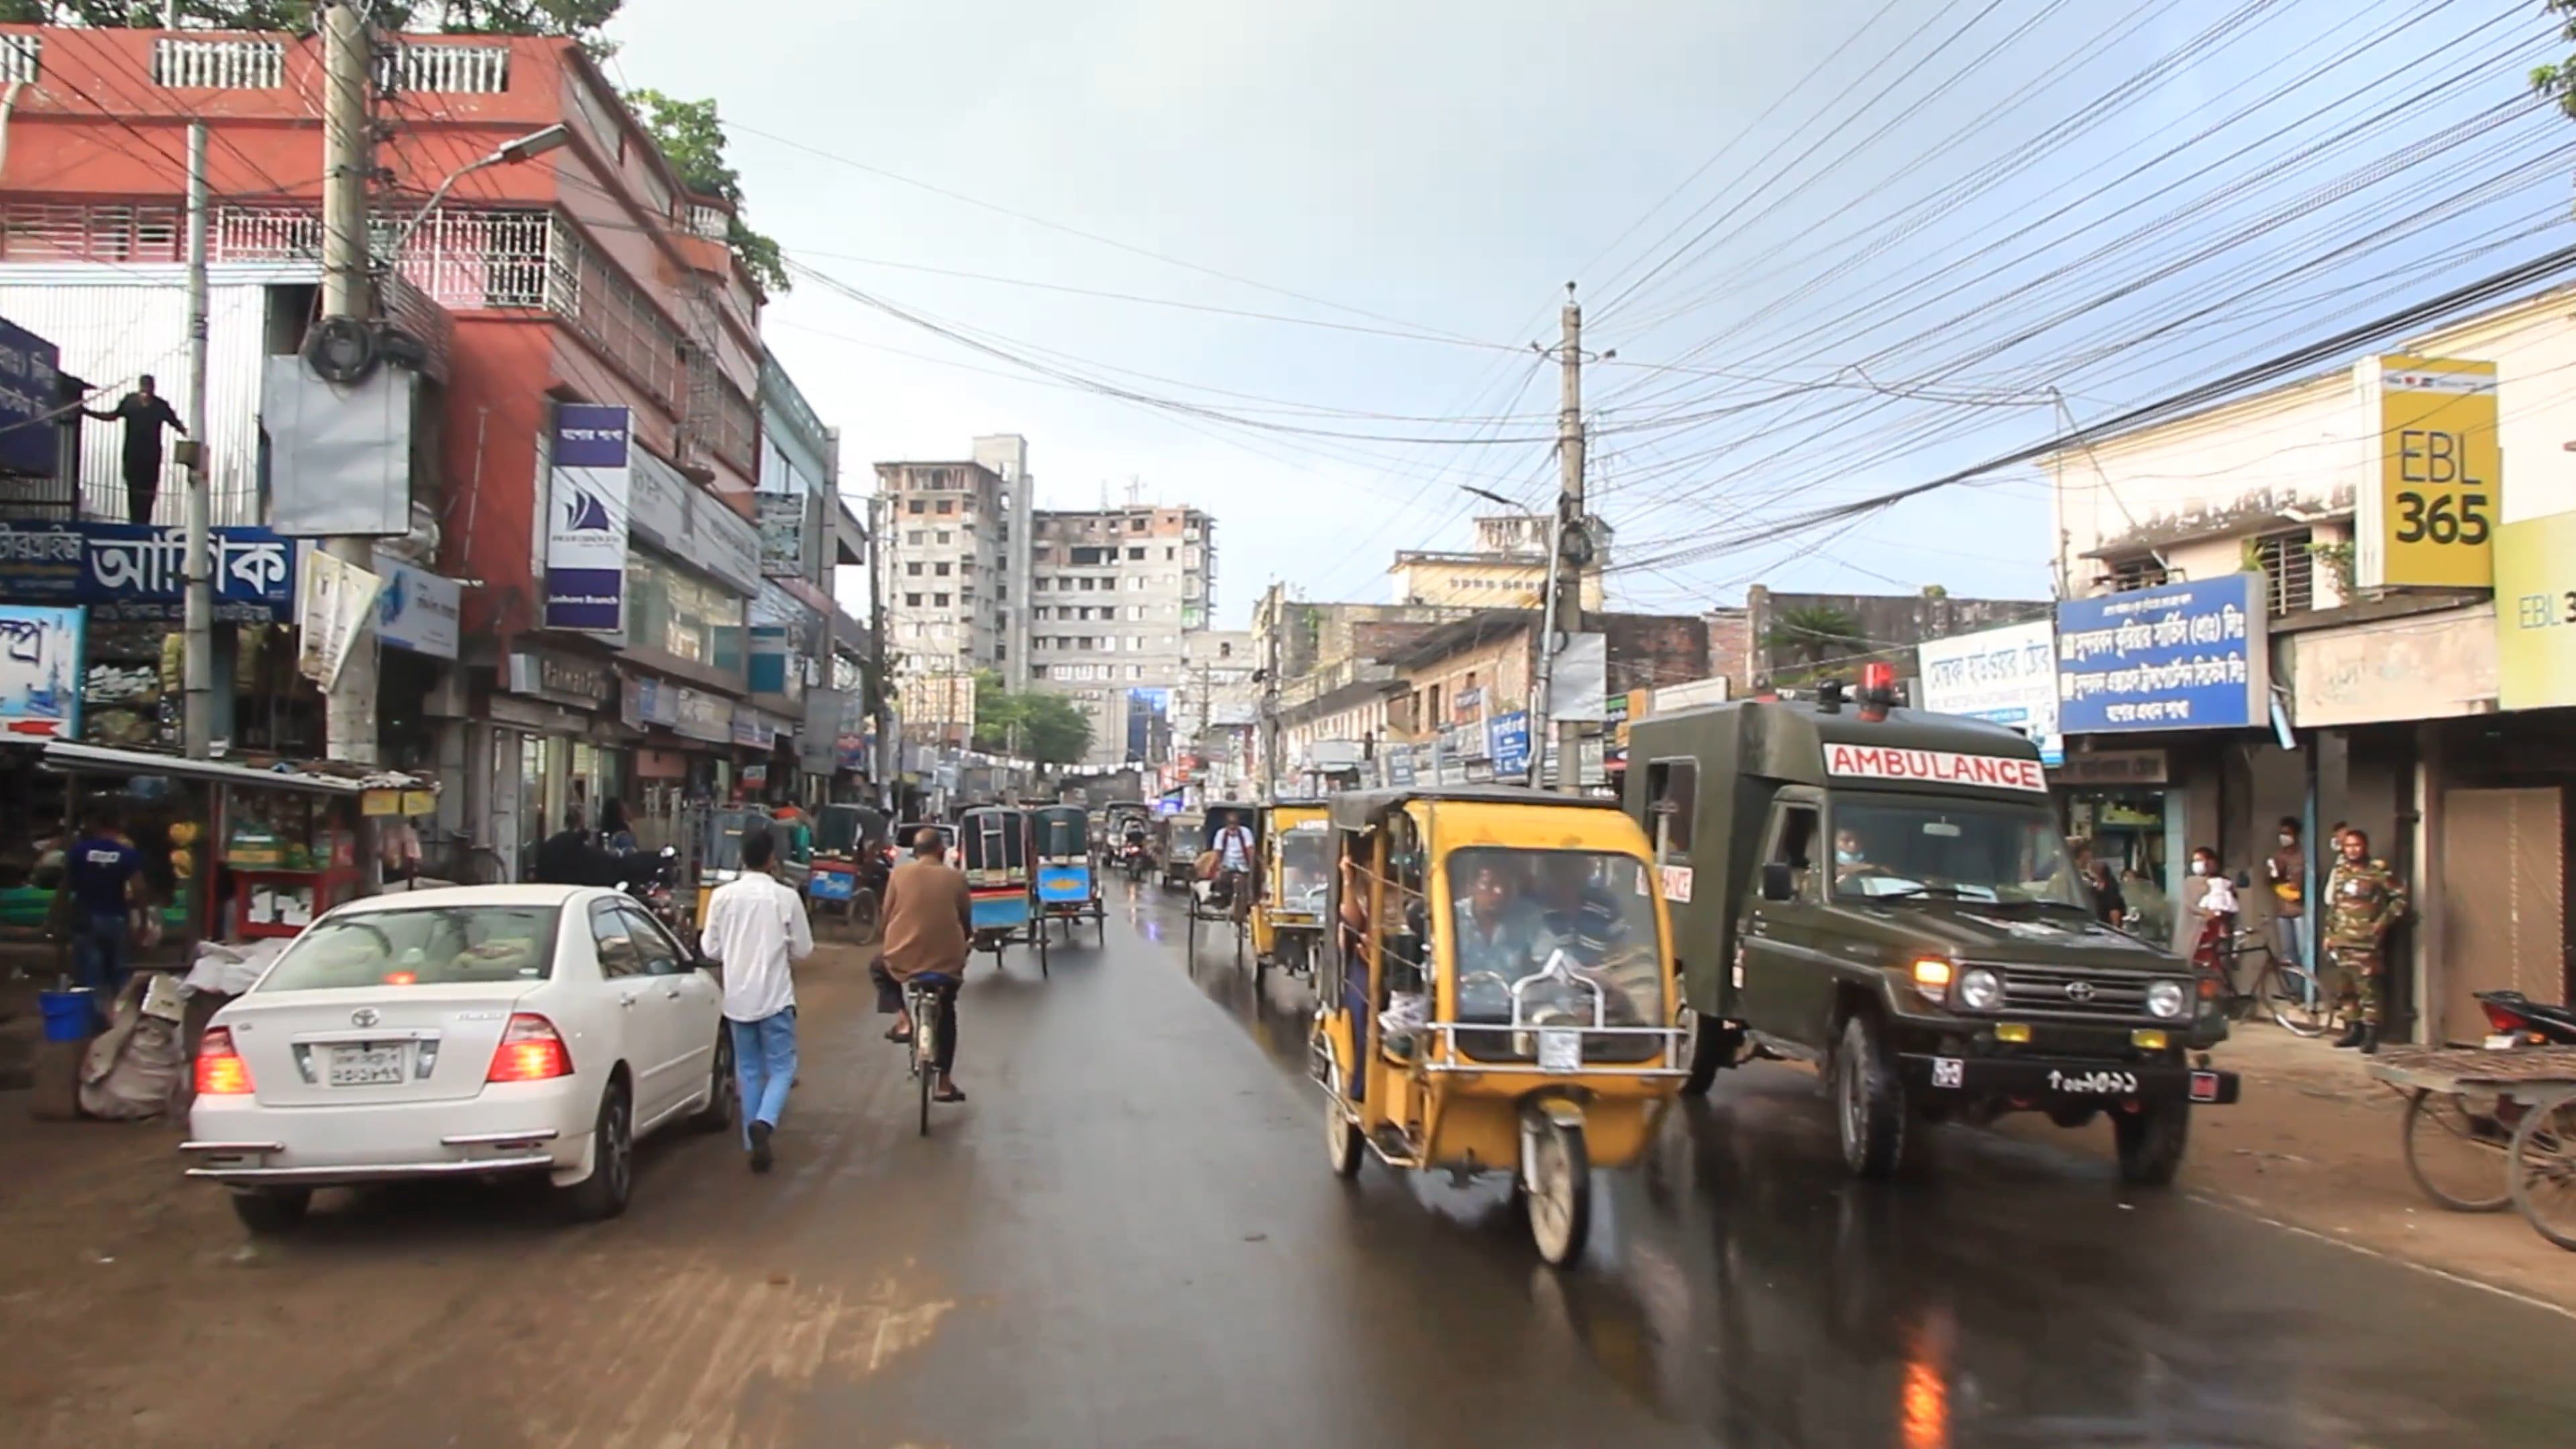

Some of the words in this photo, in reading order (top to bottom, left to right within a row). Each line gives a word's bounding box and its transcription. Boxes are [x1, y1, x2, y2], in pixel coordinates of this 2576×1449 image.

[2401, 430, 2483, 485] EBL
[2395, 492, 2489, 545] 365
[2519, 594, 2561, 629] EBL
[1833, 747, 2041, 789] AMBULANCE
